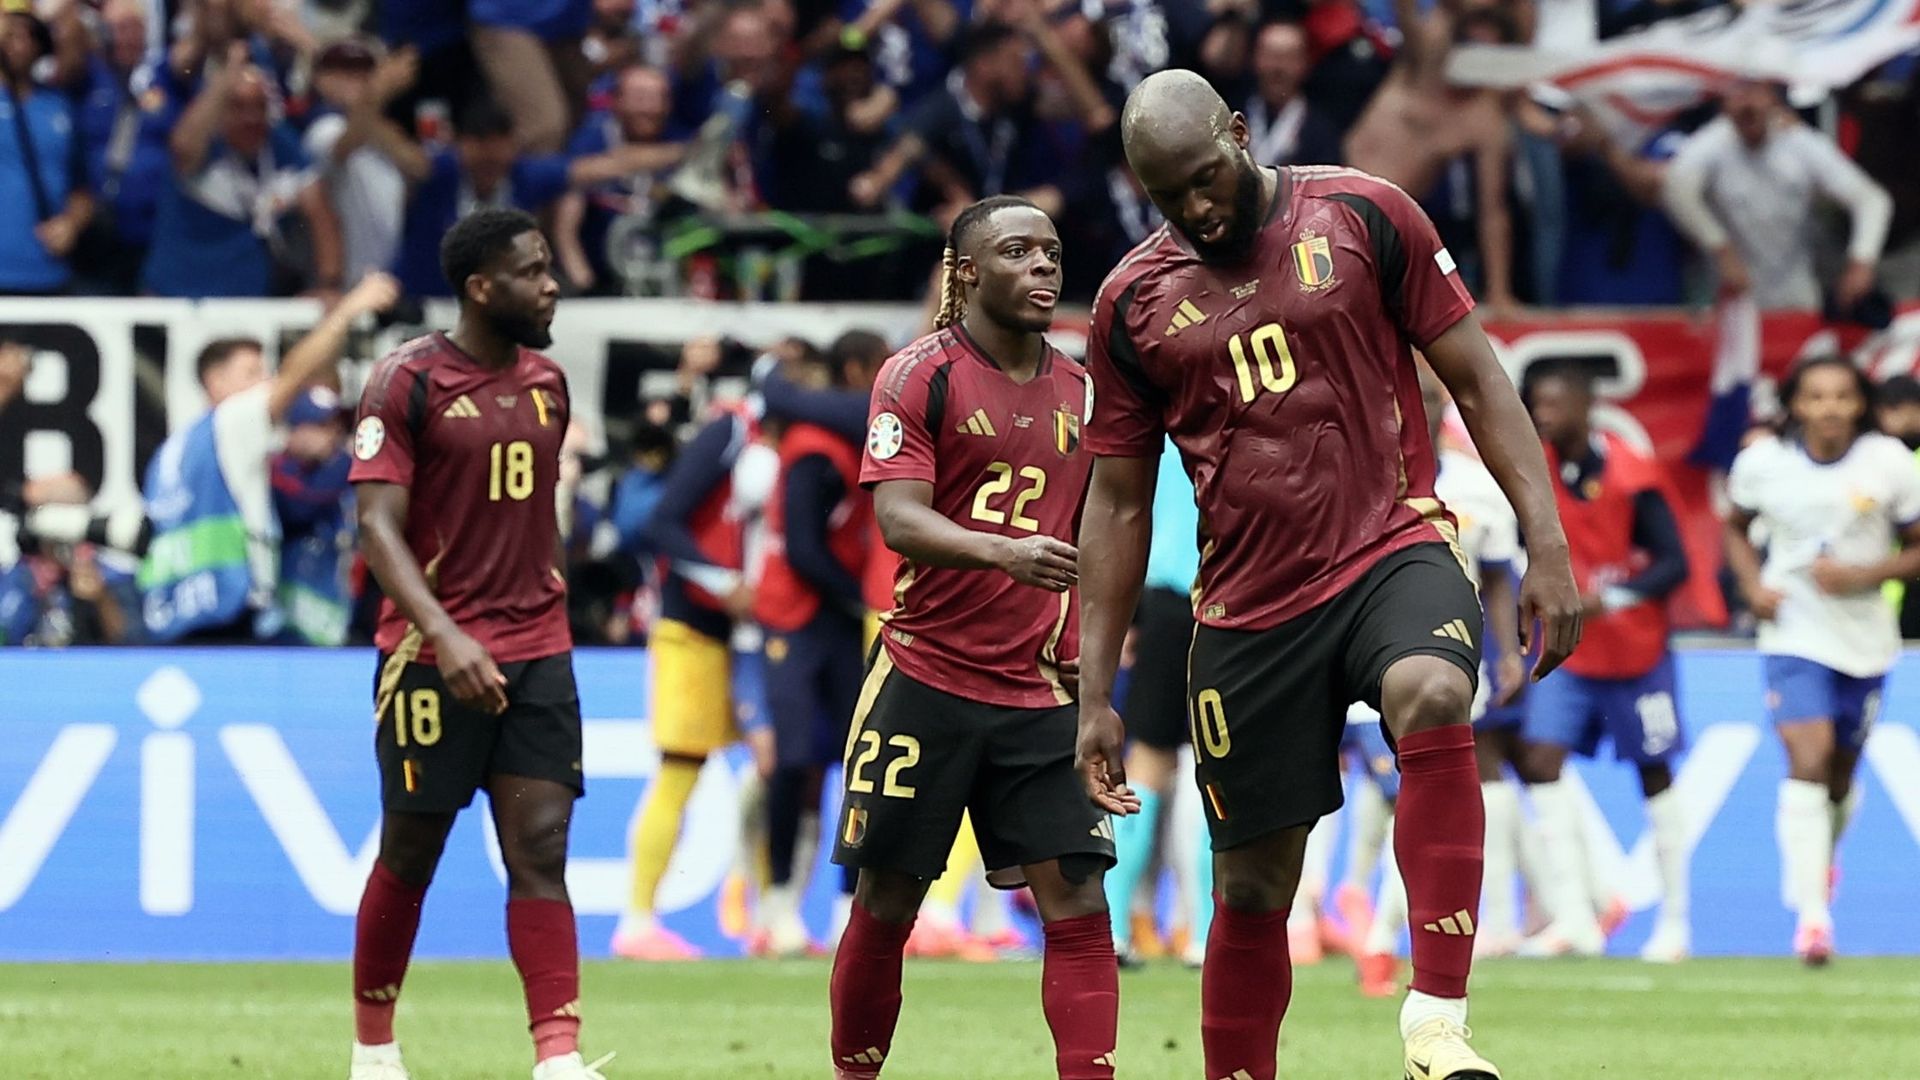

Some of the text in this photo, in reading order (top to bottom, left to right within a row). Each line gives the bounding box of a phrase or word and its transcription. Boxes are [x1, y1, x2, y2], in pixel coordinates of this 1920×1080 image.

[1228, 323, 1296, 403] 10
[489, 442, 534, 501] 18
[971, 461, 1046, 532] 22
[395, 688, 442, 746] 18
[849, 730, 920, 799] 22
